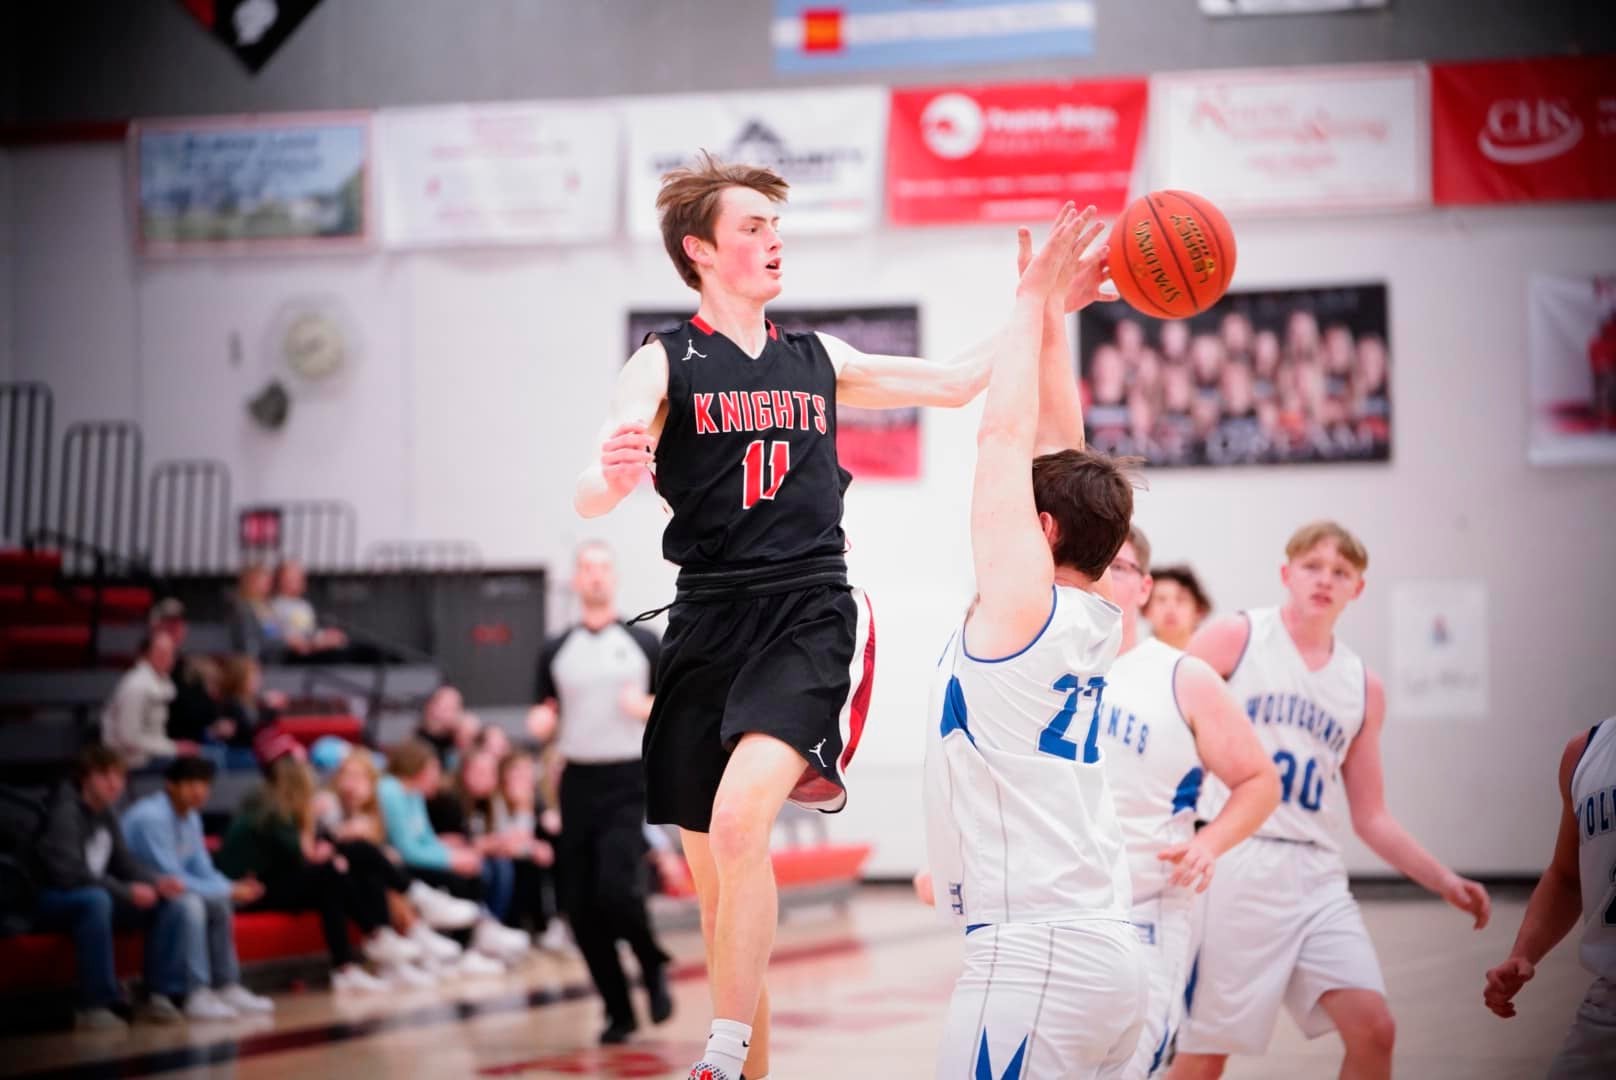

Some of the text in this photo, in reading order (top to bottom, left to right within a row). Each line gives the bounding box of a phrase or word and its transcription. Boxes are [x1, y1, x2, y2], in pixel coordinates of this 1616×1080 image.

[1486, 96, 1572, 141] CHS
[1134, 219, 1181, 304] SPALDING
[693, 390, 828, 435] KNIGHTS
[741, 439, 791, 510] 11
[1272, 748, 1324, 813] 30
